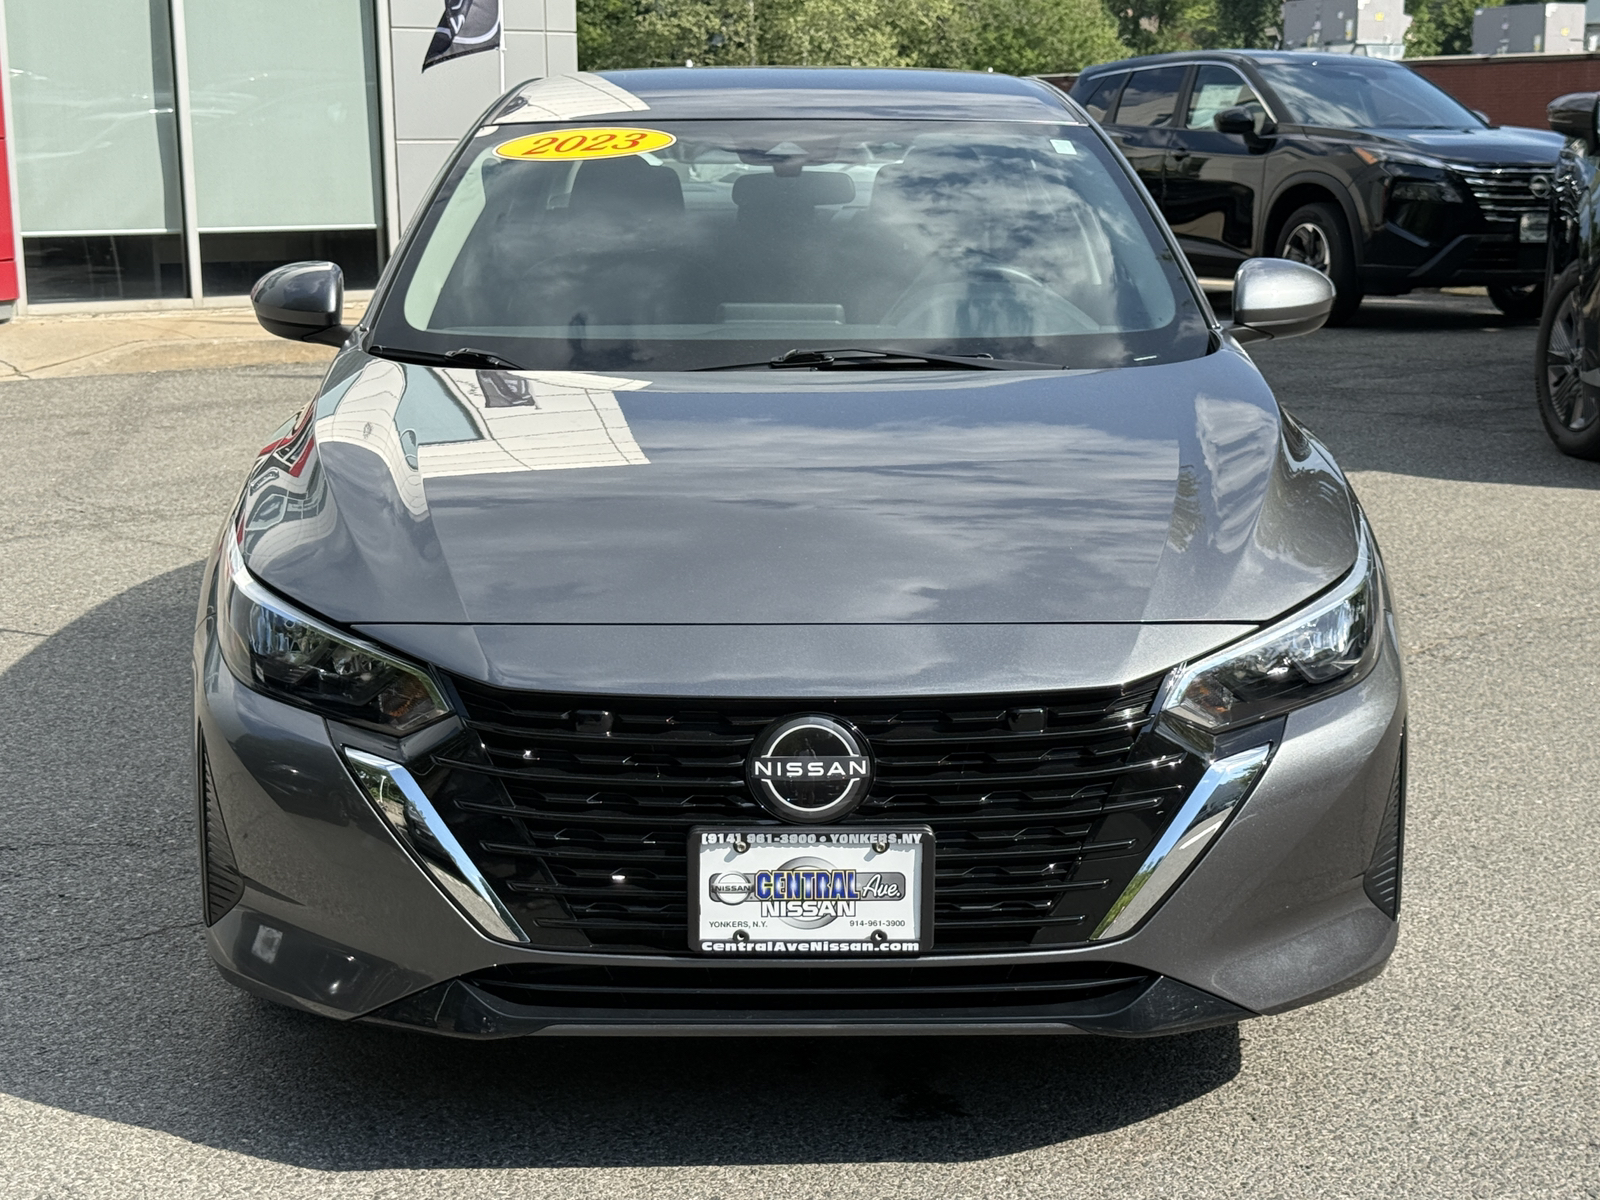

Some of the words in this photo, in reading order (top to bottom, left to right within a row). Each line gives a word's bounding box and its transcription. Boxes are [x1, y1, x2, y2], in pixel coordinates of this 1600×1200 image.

[521, 133, 648, 156] 2023
[754, 760, 867, 777] NISSAN
[754, 869, 861, 901] CENTRAL
[861, 873, 902, 898] Ave.
[761, 900, 857, 918] NISSAN
[709, 920, 751, 929] YONKERS,
[752, 920, 768, 928] N.Y.
[849, 919, 906, 928] 914-961-3900
[701, 941, 920, 952] CentralAveNissan.com
